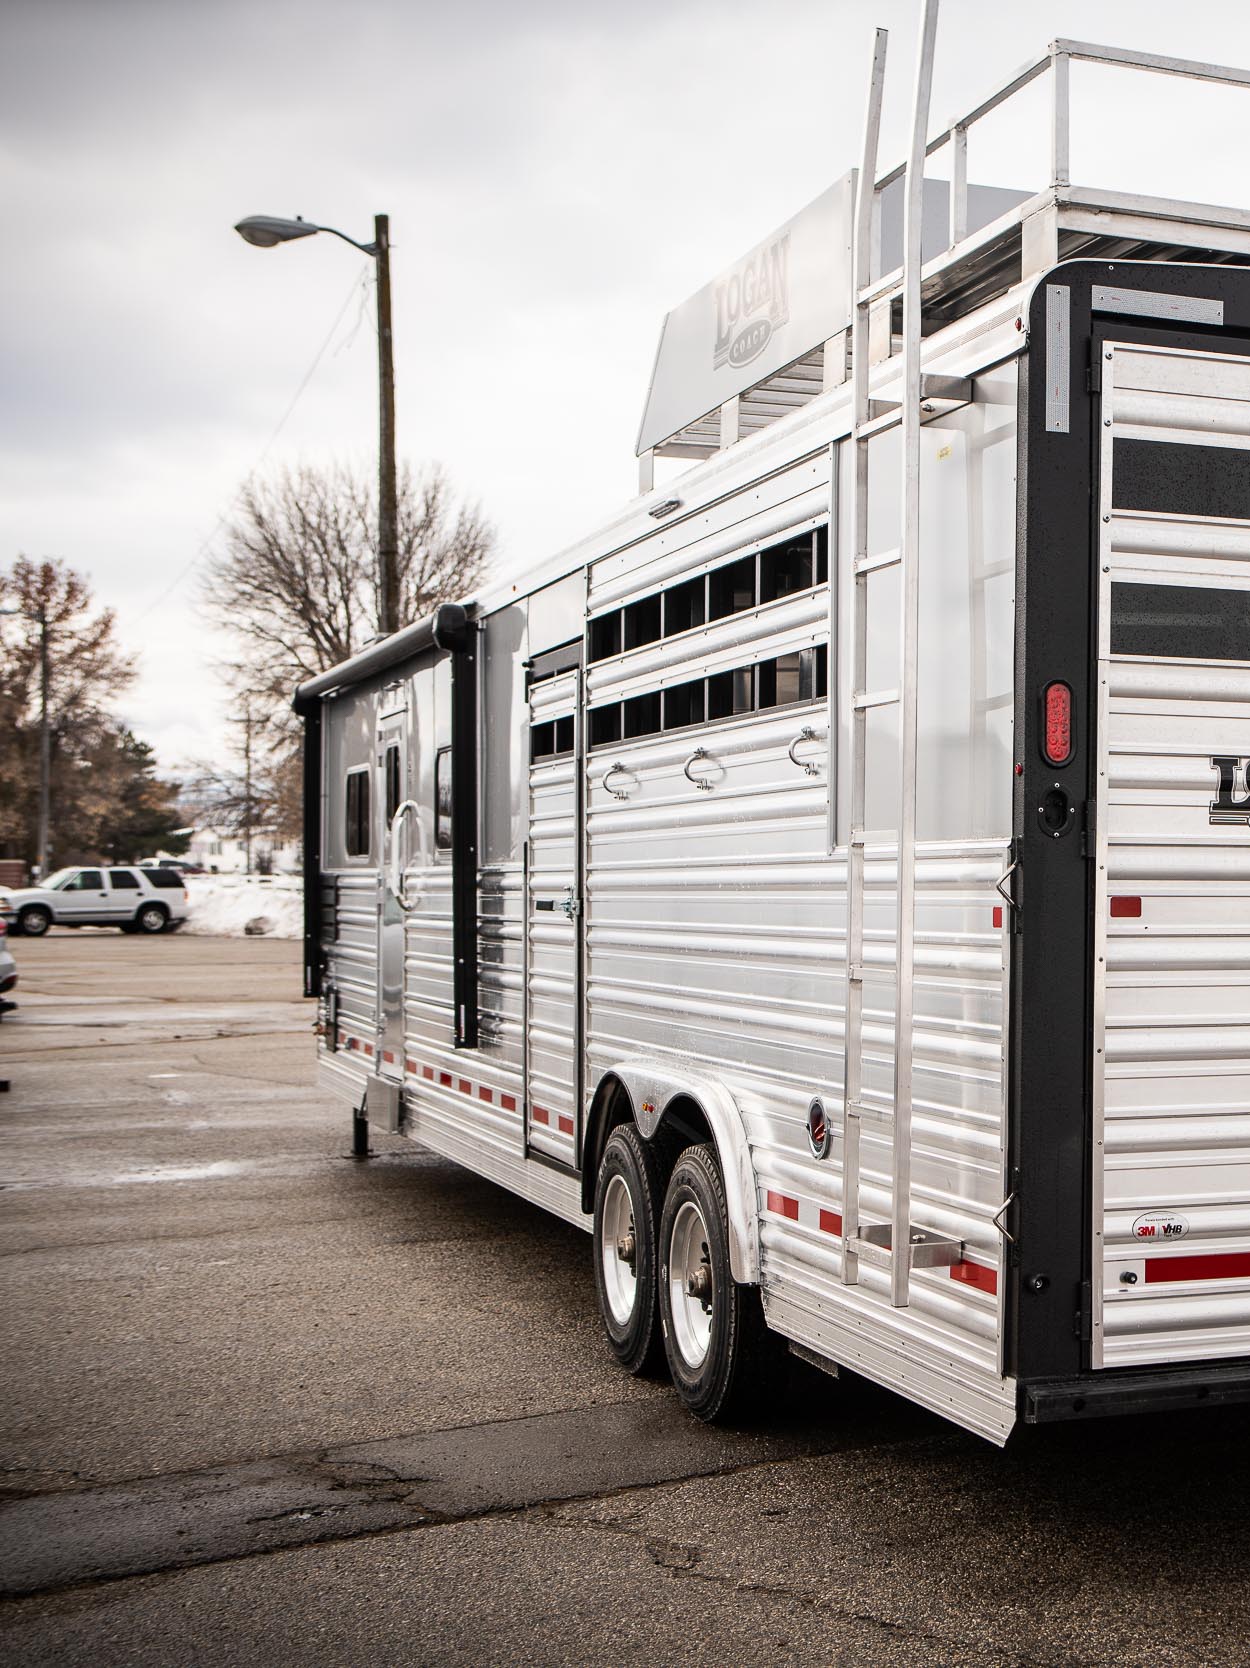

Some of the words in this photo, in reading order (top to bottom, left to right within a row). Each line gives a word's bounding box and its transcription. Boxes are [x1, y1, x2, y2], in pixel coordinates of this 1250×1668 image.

[713, 230, 791, 355] LOGAN
[733, 325, 767, 358] COACH
[1137, 1225, 1156, 1237] 3M
[1162, 1223, 1183, 1234] VHB
